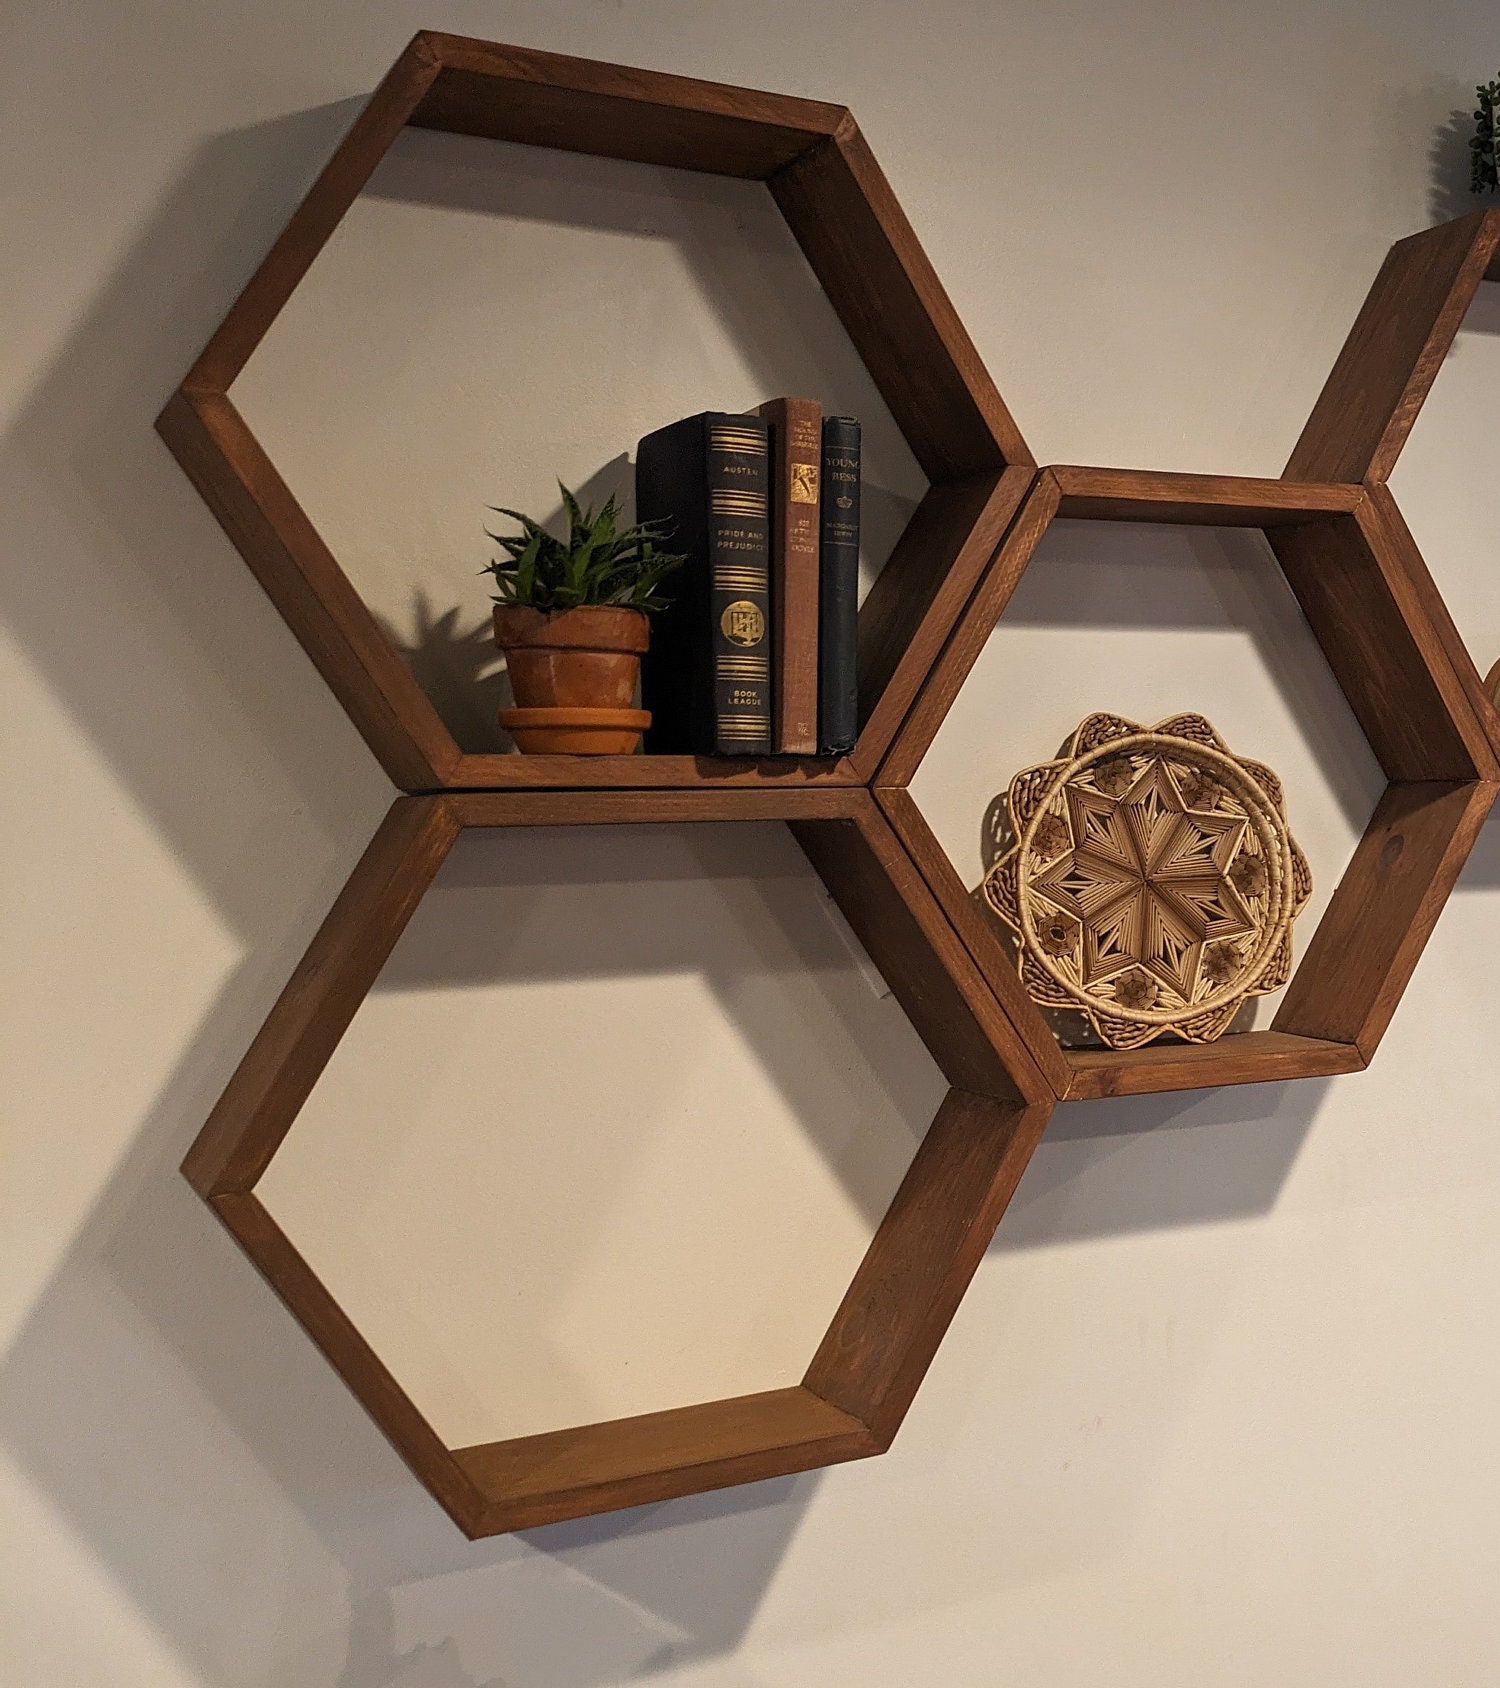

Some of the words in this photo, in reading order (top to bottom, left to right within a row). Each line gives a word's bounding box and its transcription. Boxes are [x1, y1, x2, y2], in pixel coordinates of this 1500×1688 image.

[722, 465, 759, 476] AUSTEN
[832, 472, 857, 482] BESS
[718, 529, 744, 539] PRIDE
[747, 531, 764, 540] AND
[734, 690, 757, 698] BOOK
[728, 698, 761, 706] LEAGUE
